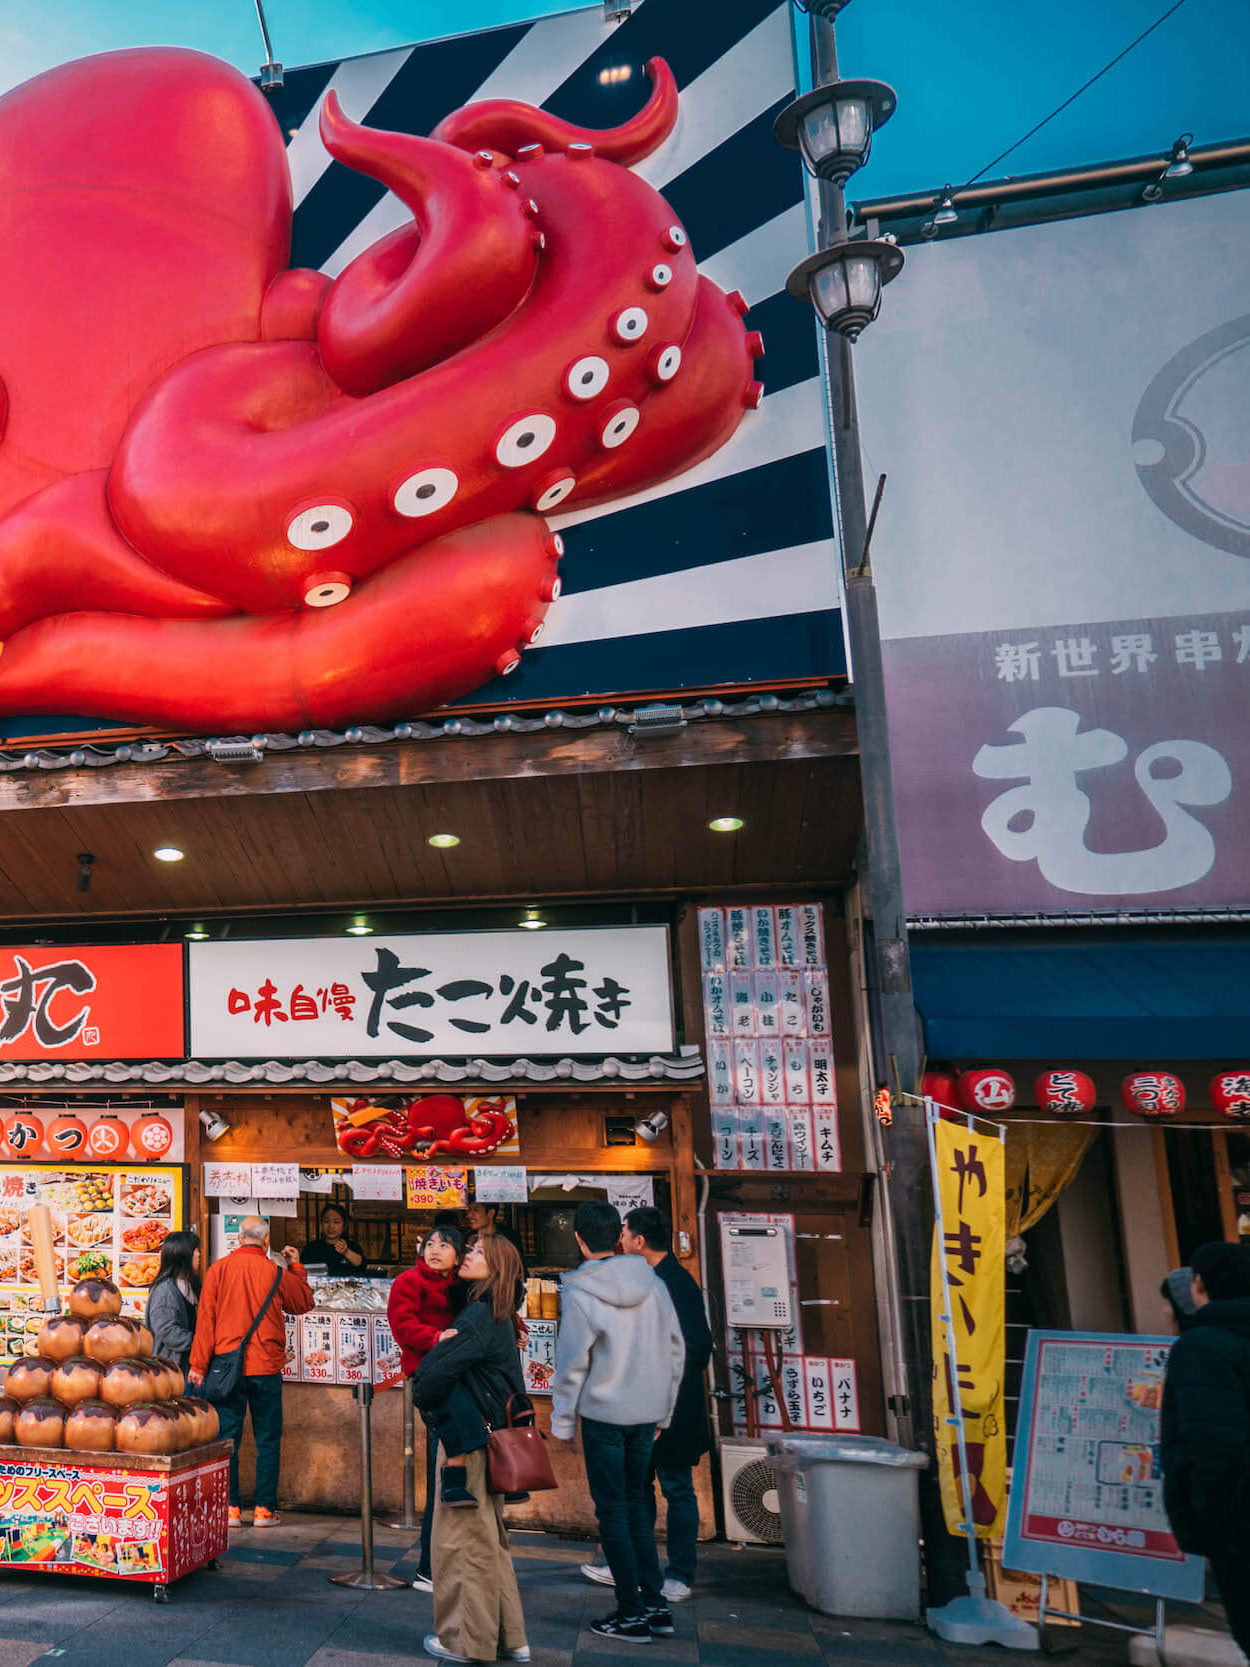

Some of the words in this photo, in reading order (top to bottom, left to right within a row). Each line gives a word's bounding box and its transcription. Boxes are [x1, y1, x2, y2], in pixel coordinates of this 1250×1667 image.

[972, 706, 1233, 894] む
[228, 978, 356, 1027] 味自慢
[361, 947, 632, 1043] たこ焼き
[766, 1055, 780, 1100] チャンジャ
[814, 1059, 829, 1095] 明太子
[819, 1127, 834, 1162] キムチ
[414, 1177, 465, 1191] 焼きいも
[304, 1316, 331, 1325] たこ焼き
[340, 1317, 367, 1327] たこ焼き
[310, 1368, 327, 1378] 330
[346, 1370, 363, 1380] 380
[530, 1379, 550, 1389] 250
[811, 1377, 827, 1416] いちご
[837, 1377, 853, 1418] バナナ
